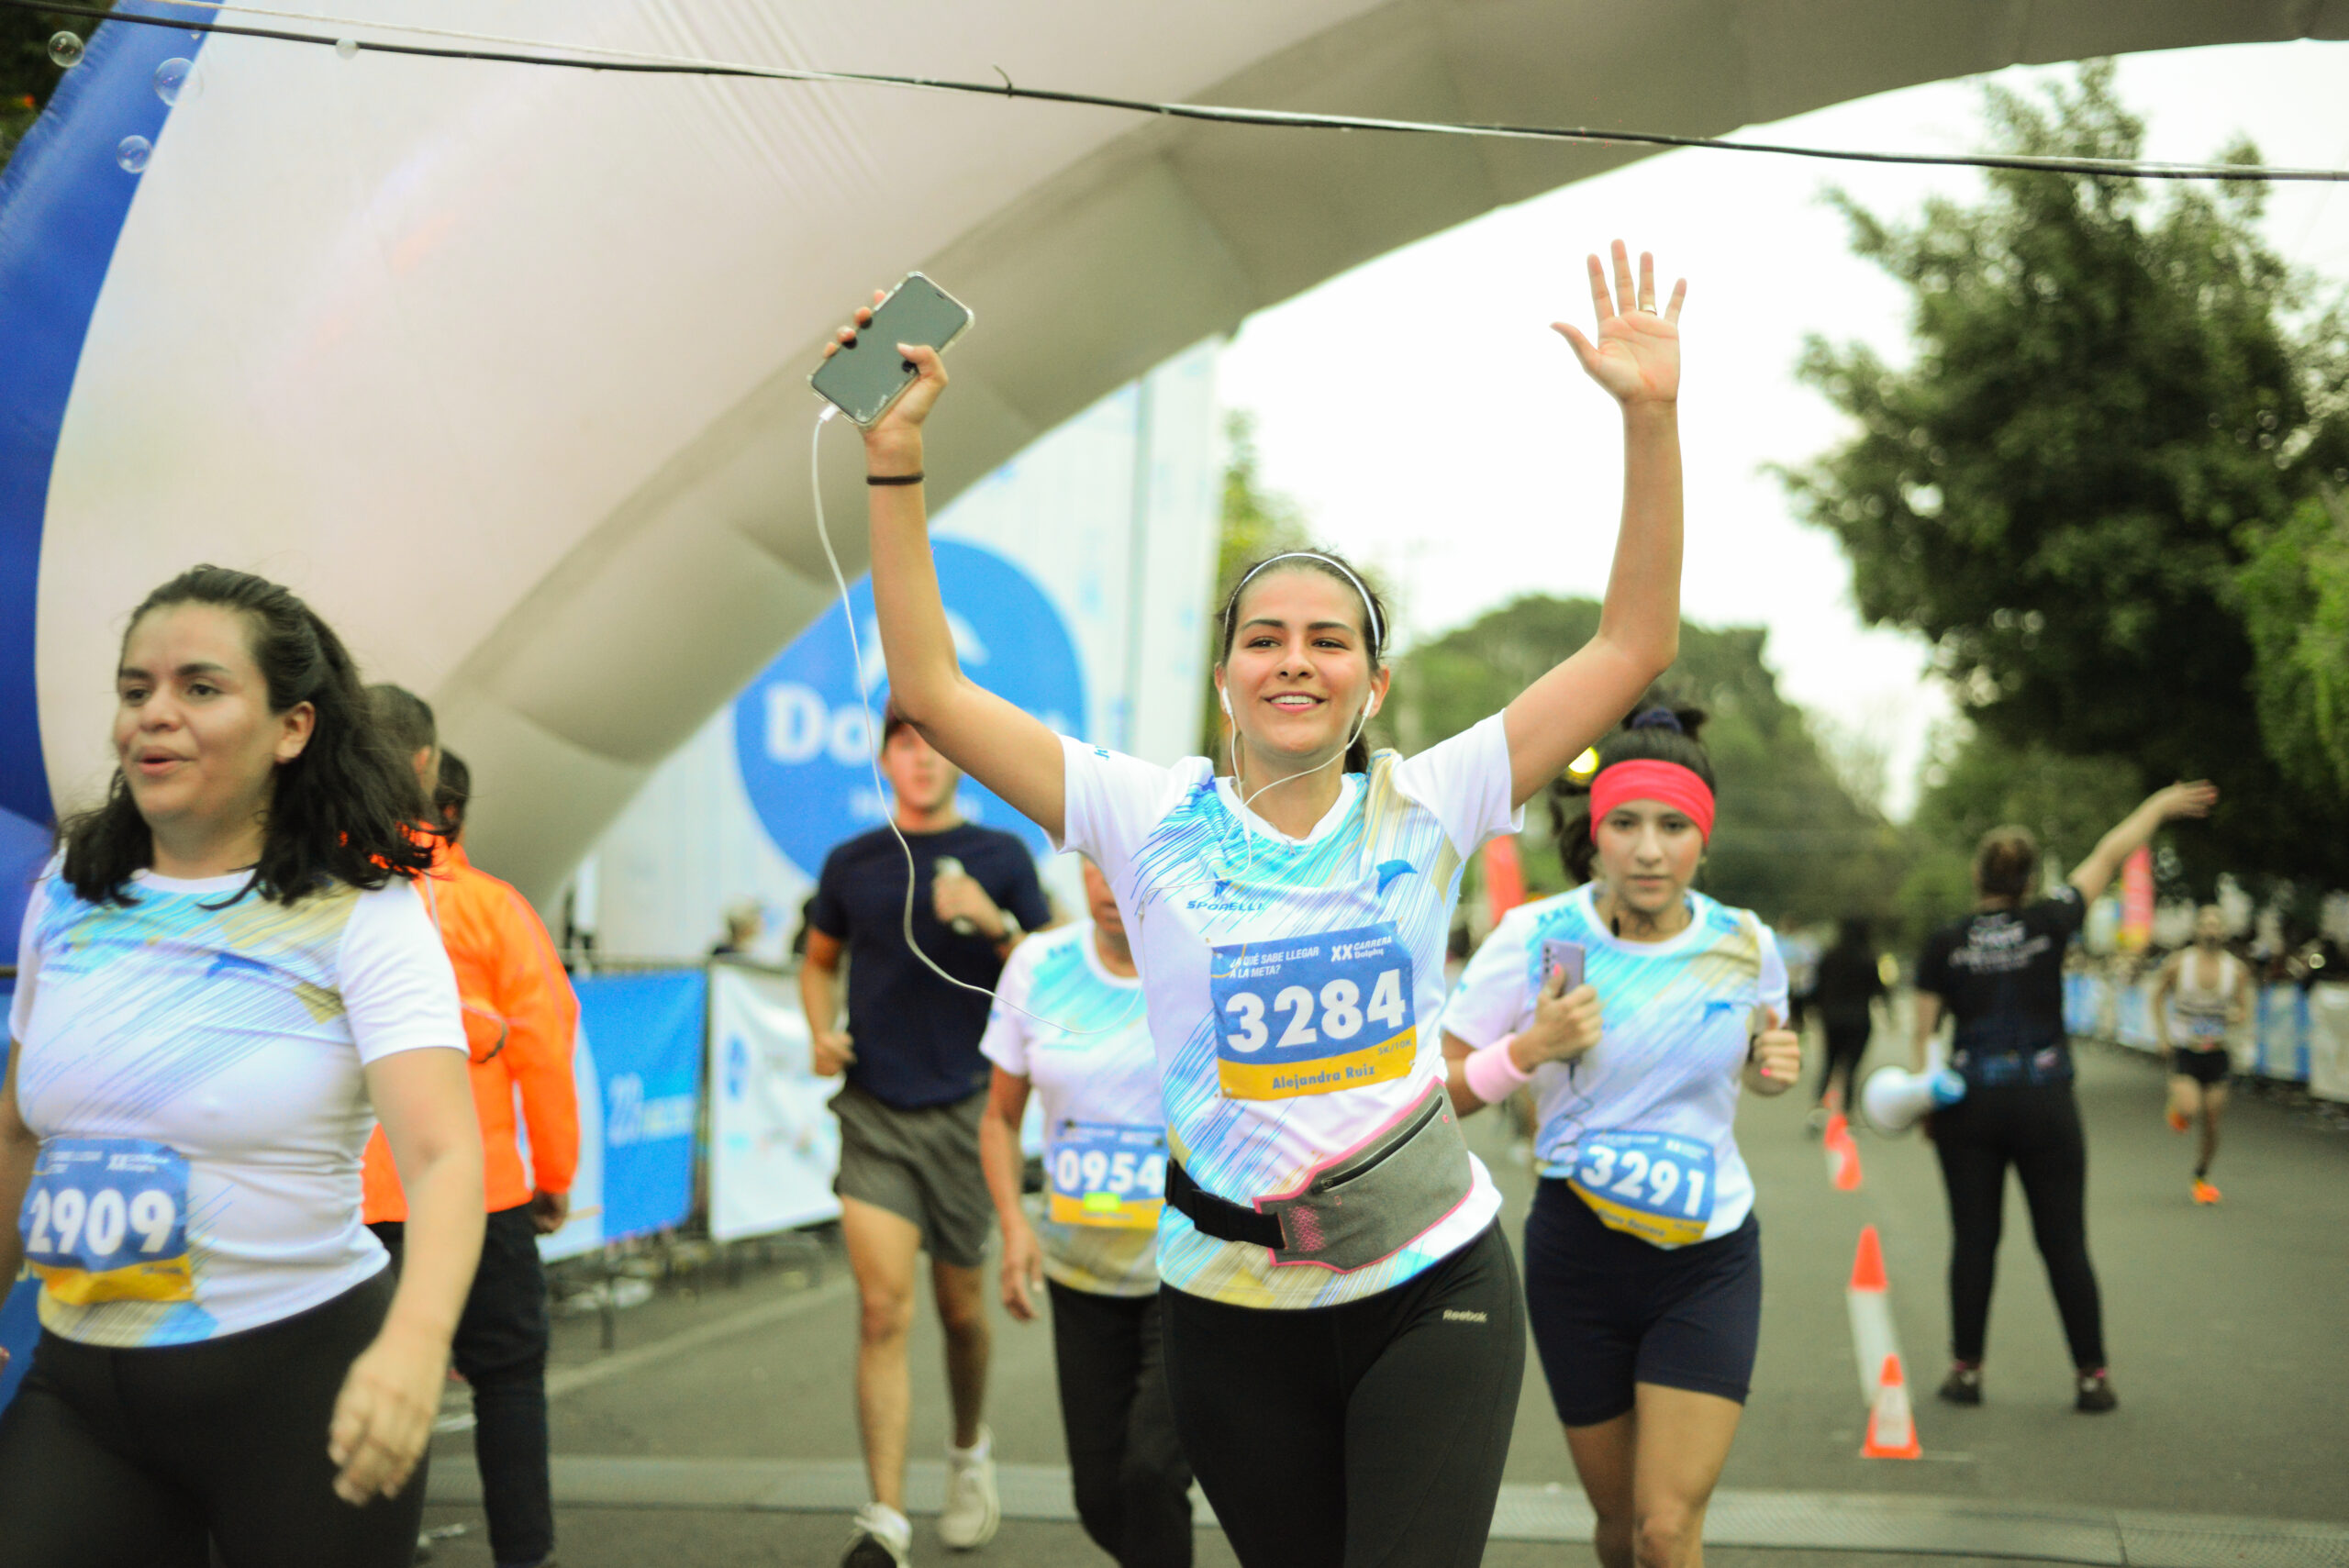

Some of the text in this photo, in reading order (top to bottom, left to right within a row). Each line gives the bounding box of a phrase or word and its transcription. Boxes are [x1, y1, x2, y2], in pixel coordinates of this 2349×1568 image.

[1243, 953, 1260, 965] QUÉ
[1261, 951, 1284, 963] SABE
[1286, 947, 1319, 961] LLEGAR
[1330, 943, 1353, 962] XX
[1353, 935, 1392, 951] CARRERA
[1239, 969, 1250, 979] LA
[1251, 964, 1281, 978] META?
[1225, 968, 1407, 1053] 3284
[1272, 1062, 1375, 1090] Alejandra Ruiz
[1057, 1149, 1165, 1195] 0954
[1580, 1145, 1706, 1218] 3291
[26, 1187, 176, 1256] 2909
